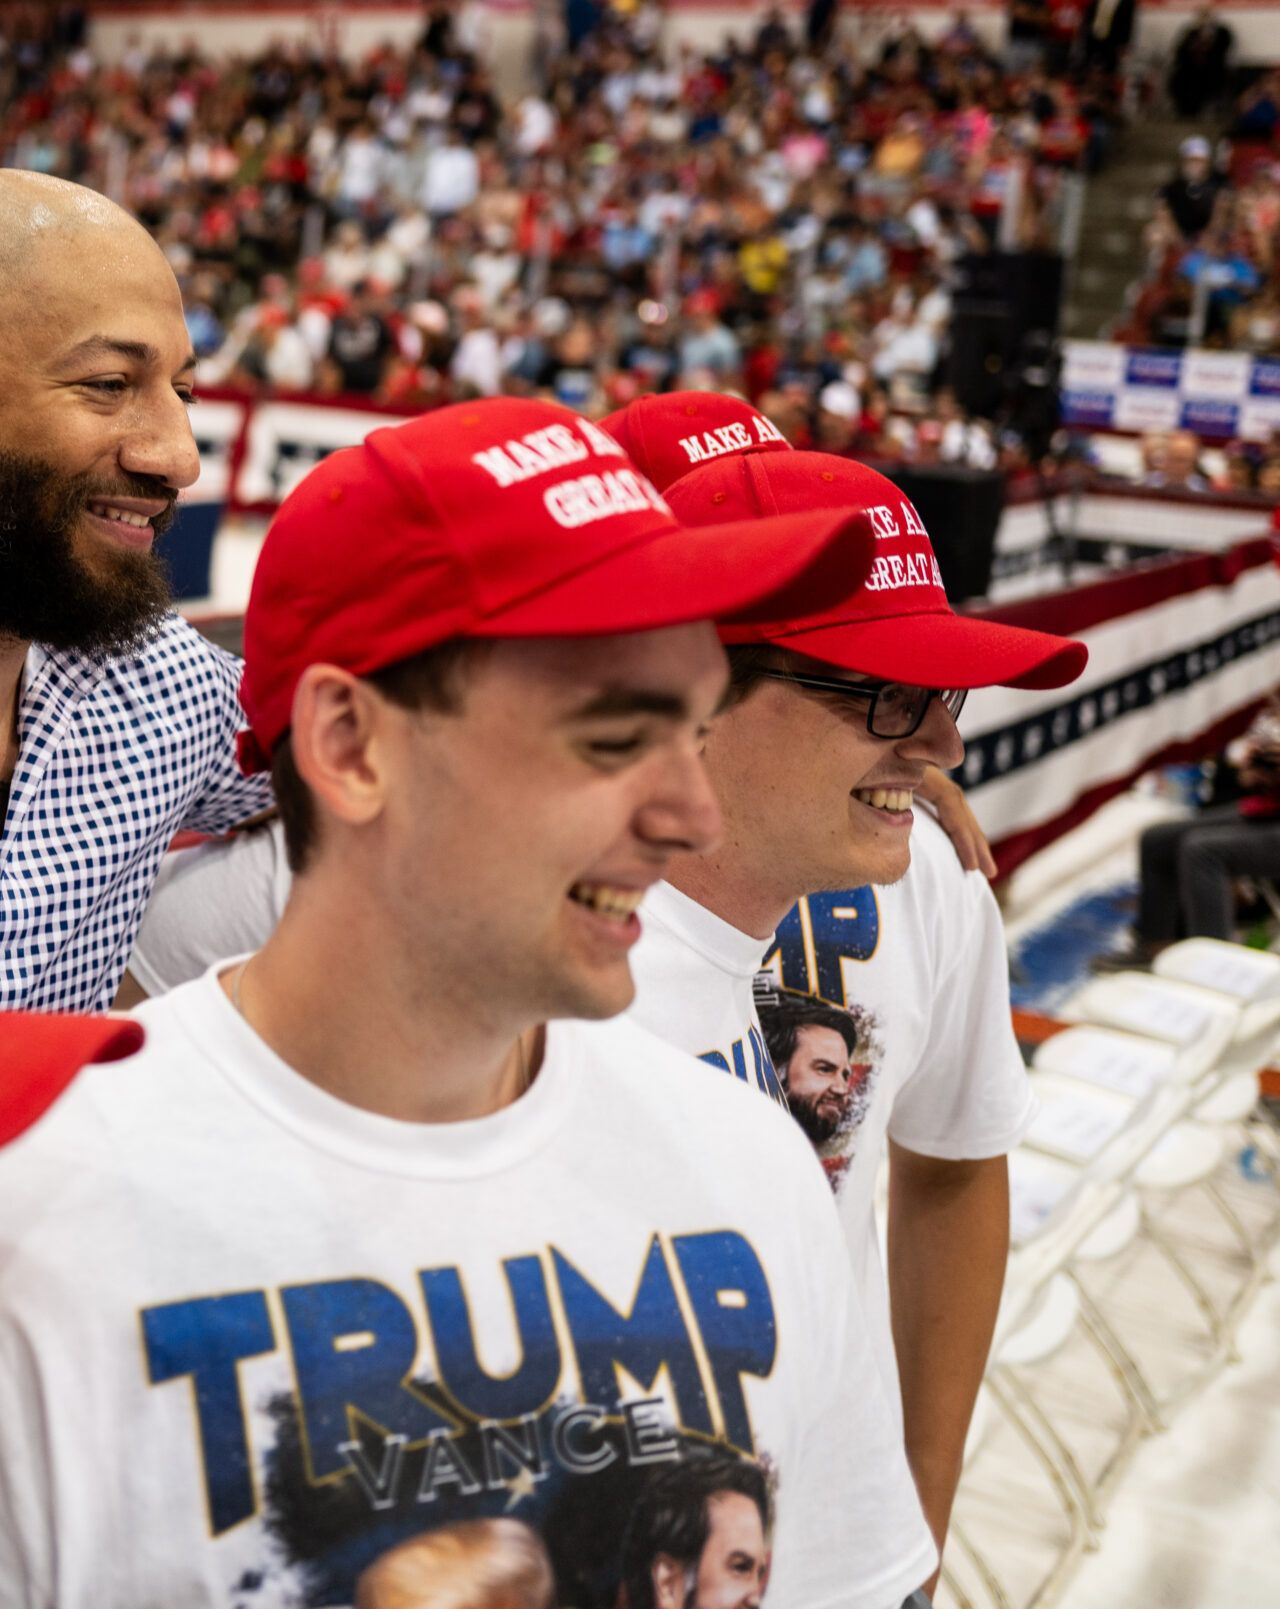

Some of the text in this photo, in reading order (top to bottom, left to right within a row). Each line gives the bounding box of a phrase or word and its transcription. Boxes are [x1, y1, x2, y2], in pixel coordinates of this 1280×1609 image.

[472, 423, 589, 489] MAKE
[678, 421, 753, 464] MAKE
[543, 468, 651, 529] GREAT
[138, 1229, 780, 1541] TRUMP
[337, 1396, 683, 1510] VANCE
